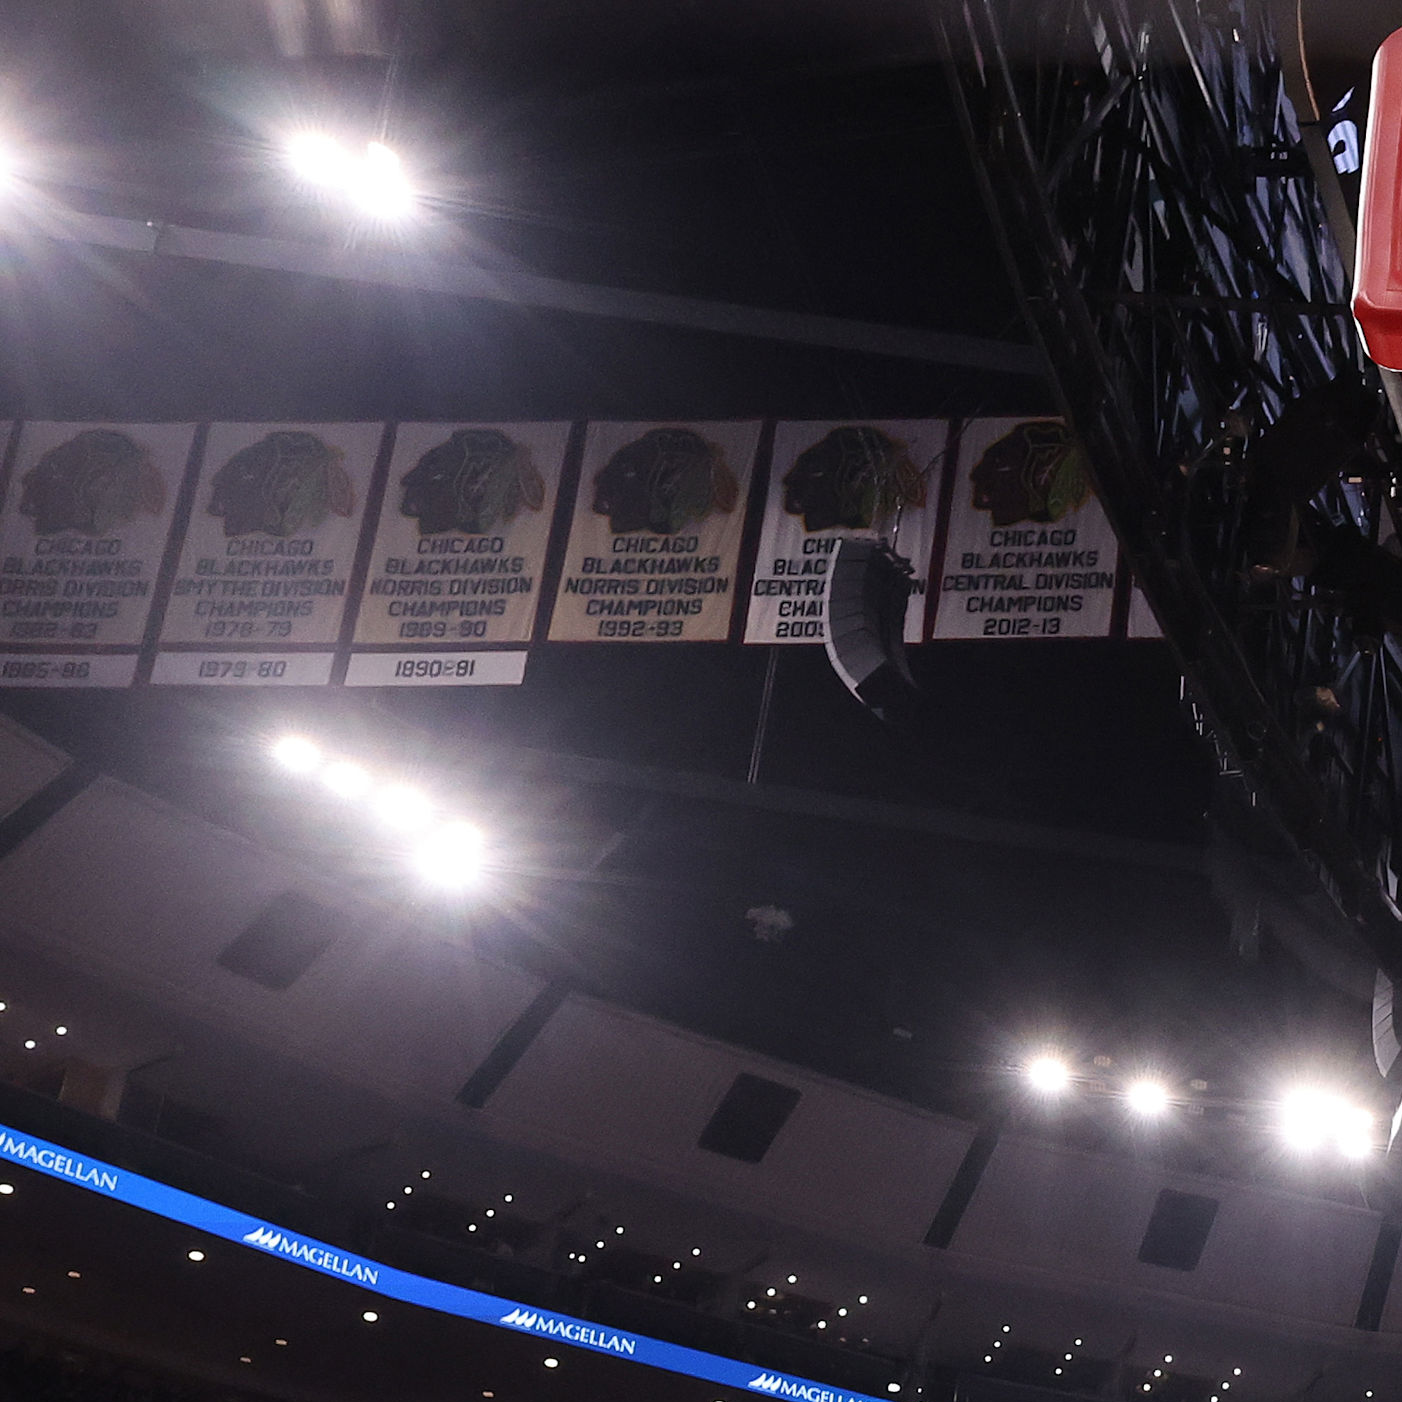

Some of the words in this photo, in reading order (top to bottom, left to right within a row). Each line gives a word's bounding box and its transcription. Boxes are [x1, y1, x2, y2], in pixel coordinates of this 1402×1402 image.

[612, 538, 698, 554] CHICAGO
[990, 530, 1076, 547] CHICAGO
[582, 557, 720, 574] BLACKHAWKS
[961, 551, 1098, 569] BLACKHAWKS
[565, 578, 639, 596] NORRIS
[646, 578, 729, 595] DIVISION
[942, 573, 1029, 591] CENTRAL
[1035, 572, 1113, 590] DIVISION
[586, 599, 703, 616] CHAMPIONS
[965, 595, 1083, 613] CHAMPIONS
[983, 618, 1061, 635] 2012-13
[3, 1132, 118, 1192] MAGELLAN
[279, 1234, 379, 1286] MAGELLAN
[536, 1316, 636, 1356] MAGELLAN
